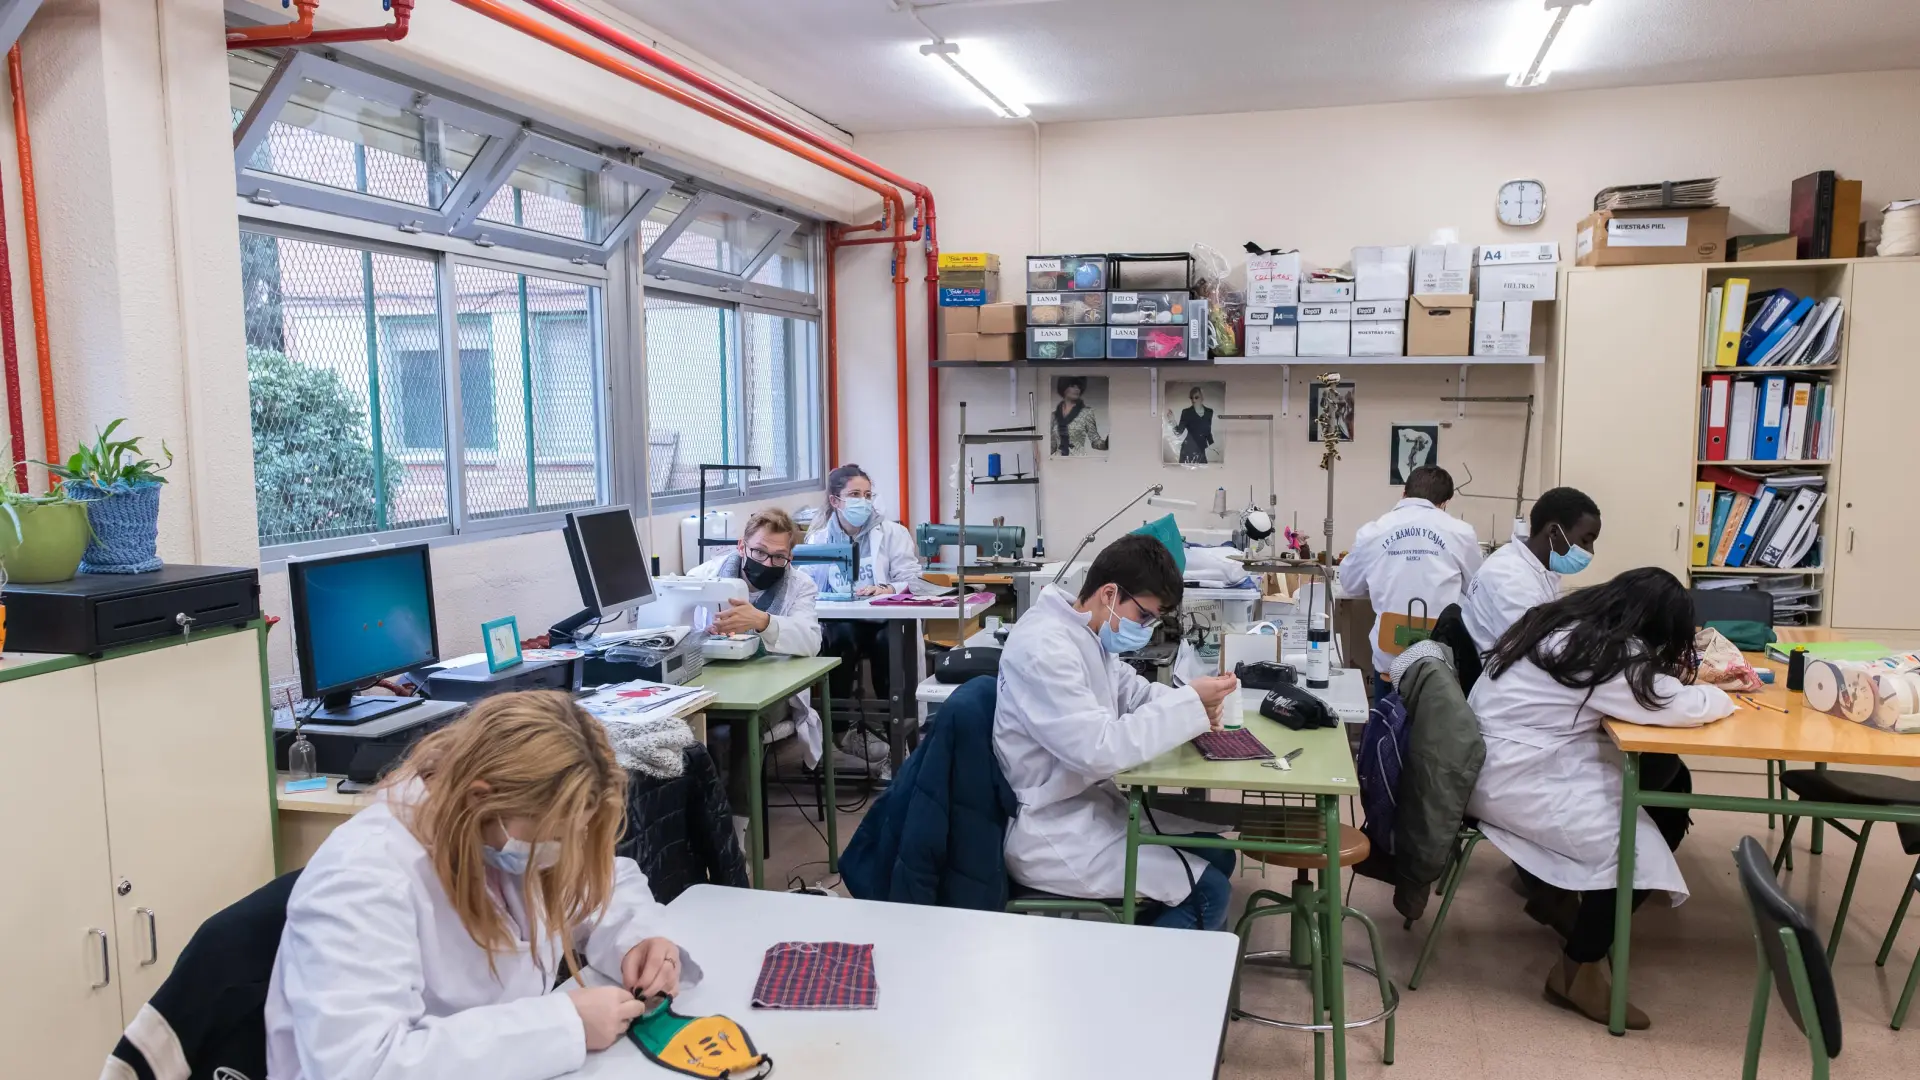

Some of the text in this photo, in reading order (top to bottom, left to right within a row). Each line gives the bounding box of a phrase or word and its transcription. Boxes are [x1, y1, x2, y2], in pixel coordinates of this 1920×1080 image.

[1484, 251, 1502, 260] A4
[1395, 526, 1421, 540] RAMÓN
[1422, 528, 1428, 537] Y
[1427, 530, 1446, 550] CAJAL
